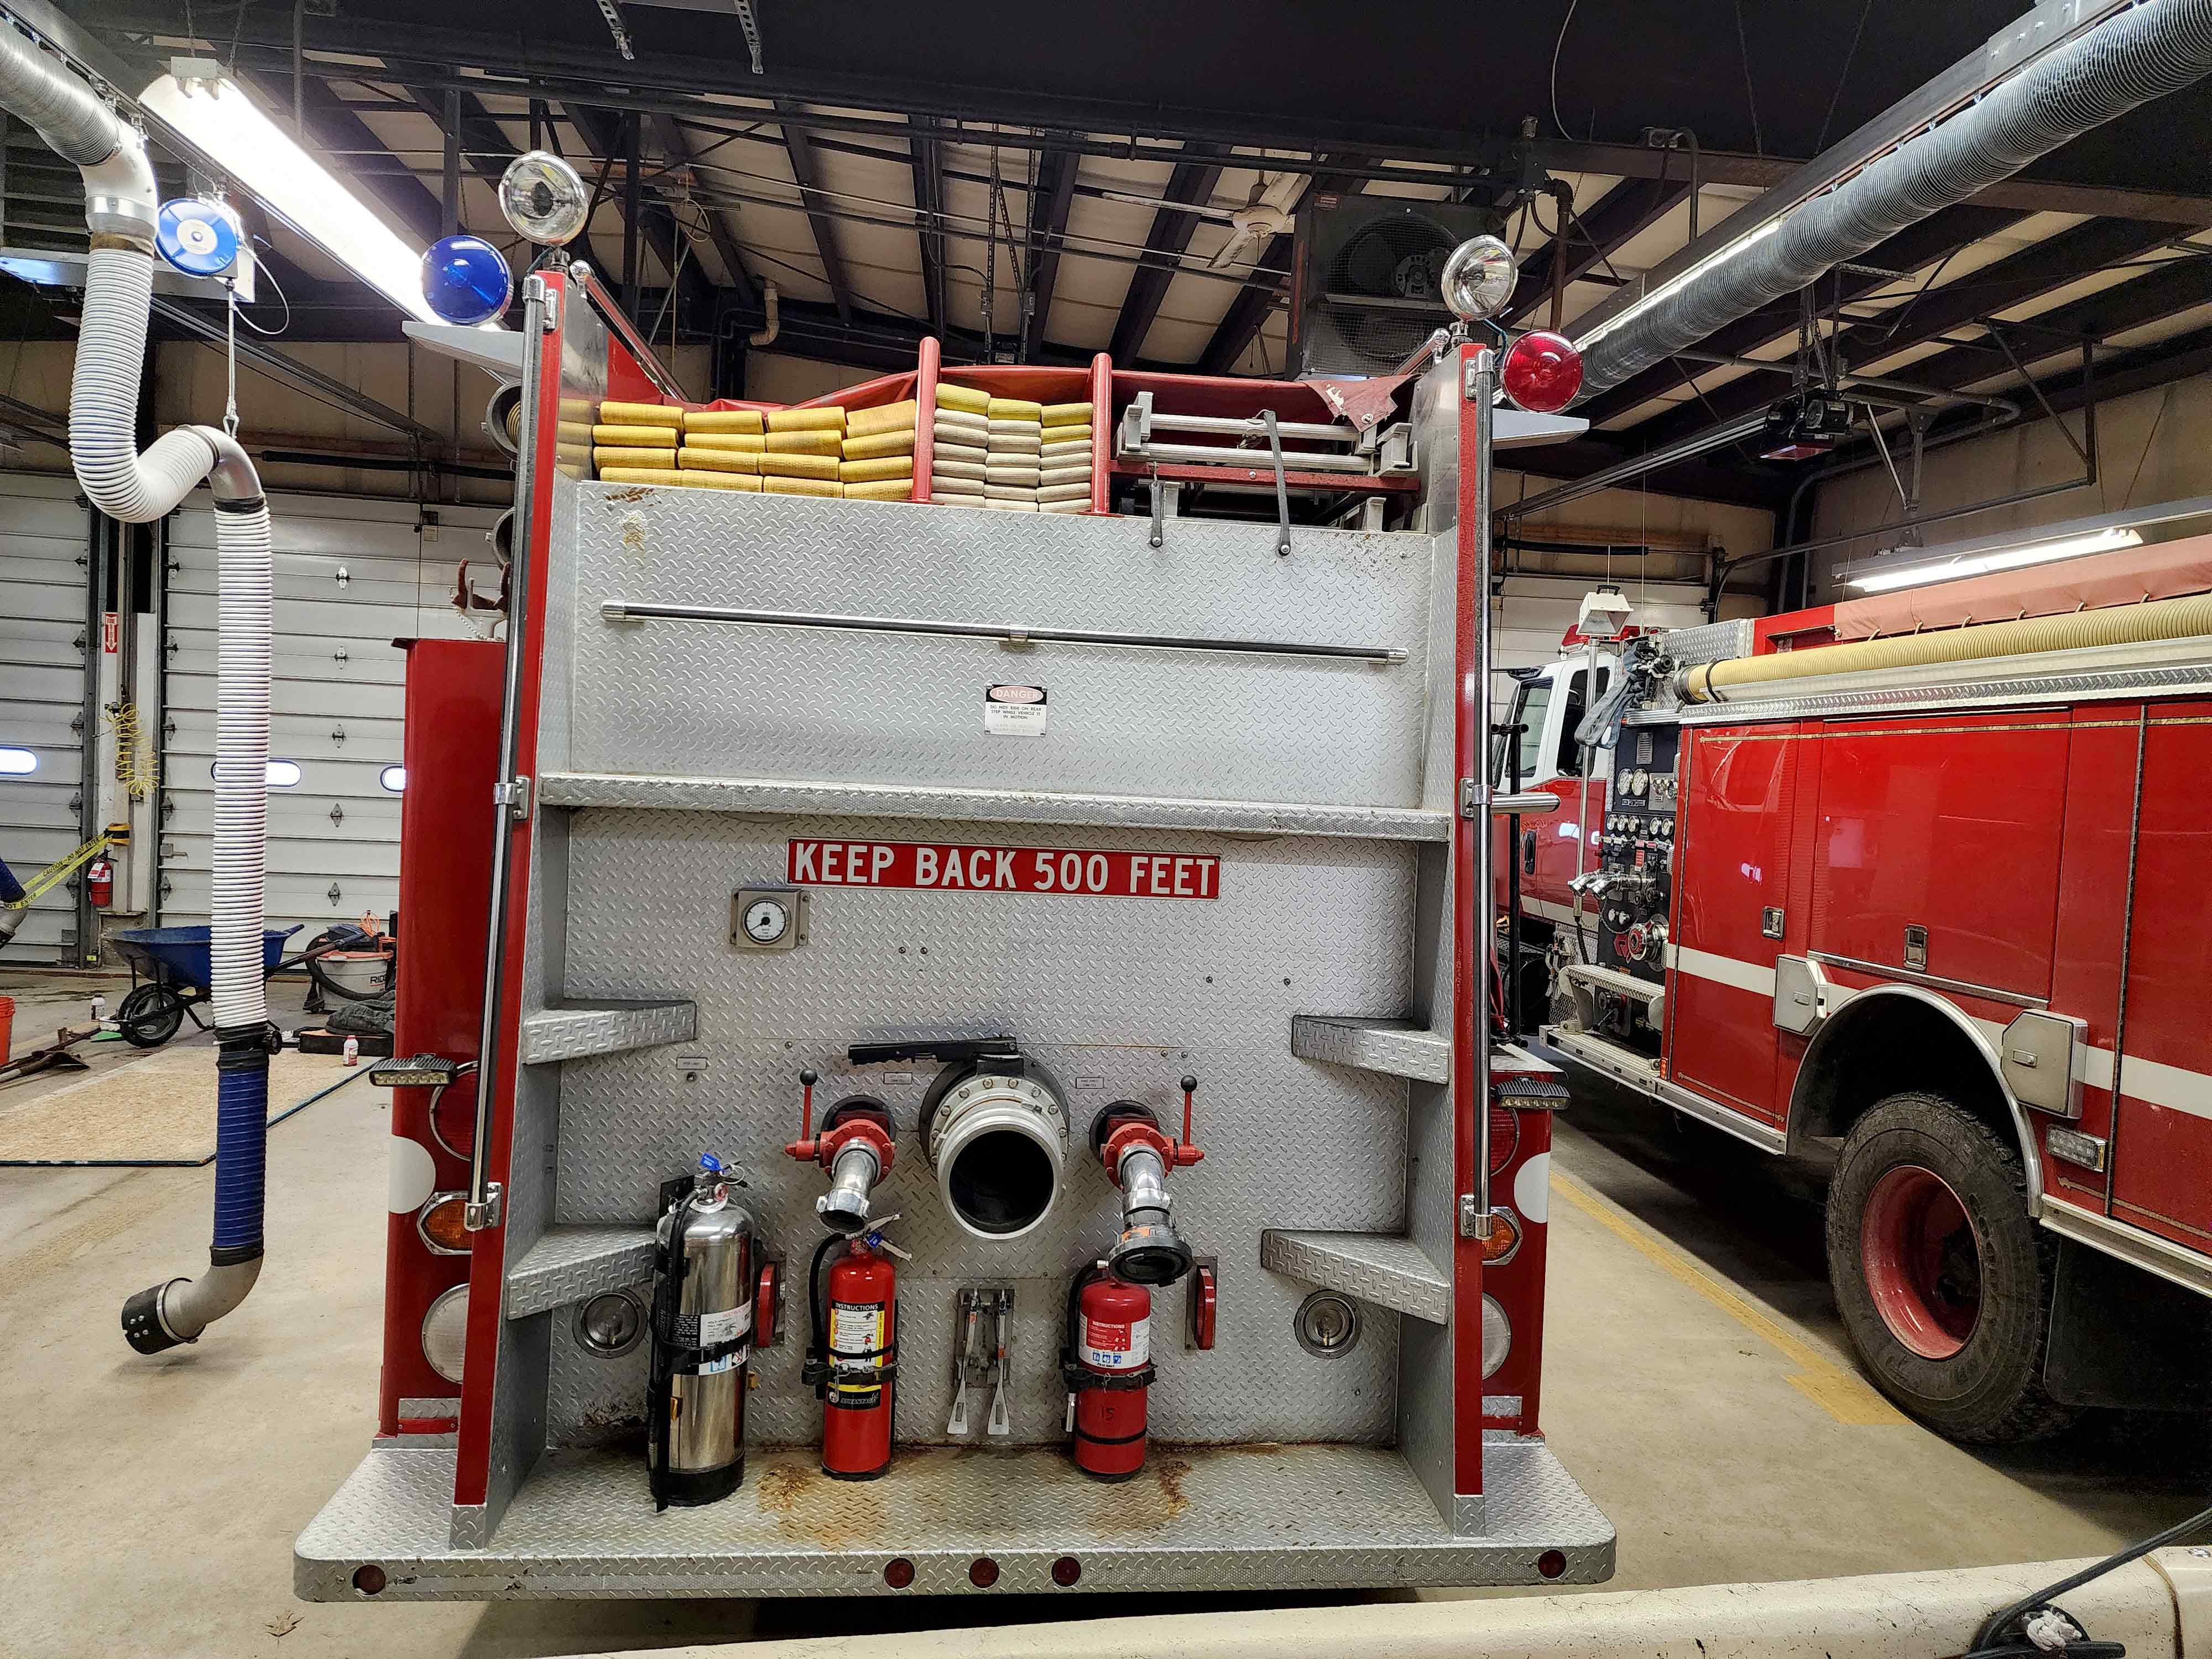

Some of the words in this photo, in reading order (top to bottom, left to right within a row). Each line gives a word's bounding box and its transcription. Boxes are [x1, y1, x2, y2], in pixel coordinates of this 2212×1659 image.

[43, 860, 63, 877] CAUTION
[75, 846, 85, 855] NOT
[85, 837, 100, 848] ENTER
[795, 843, 894, 883] KEEP
[916, 848, 1017, 888] BACK
[1034, 852, 1108, 892] 500
[1130, 856, 1215, 896] FEET
[21, 893, 36, 906] ENTER
[836, 1302, 878, 1311] INSTRUCTIONS
[1092, 1321, 1125, 1329] INSTRUCTIONS
